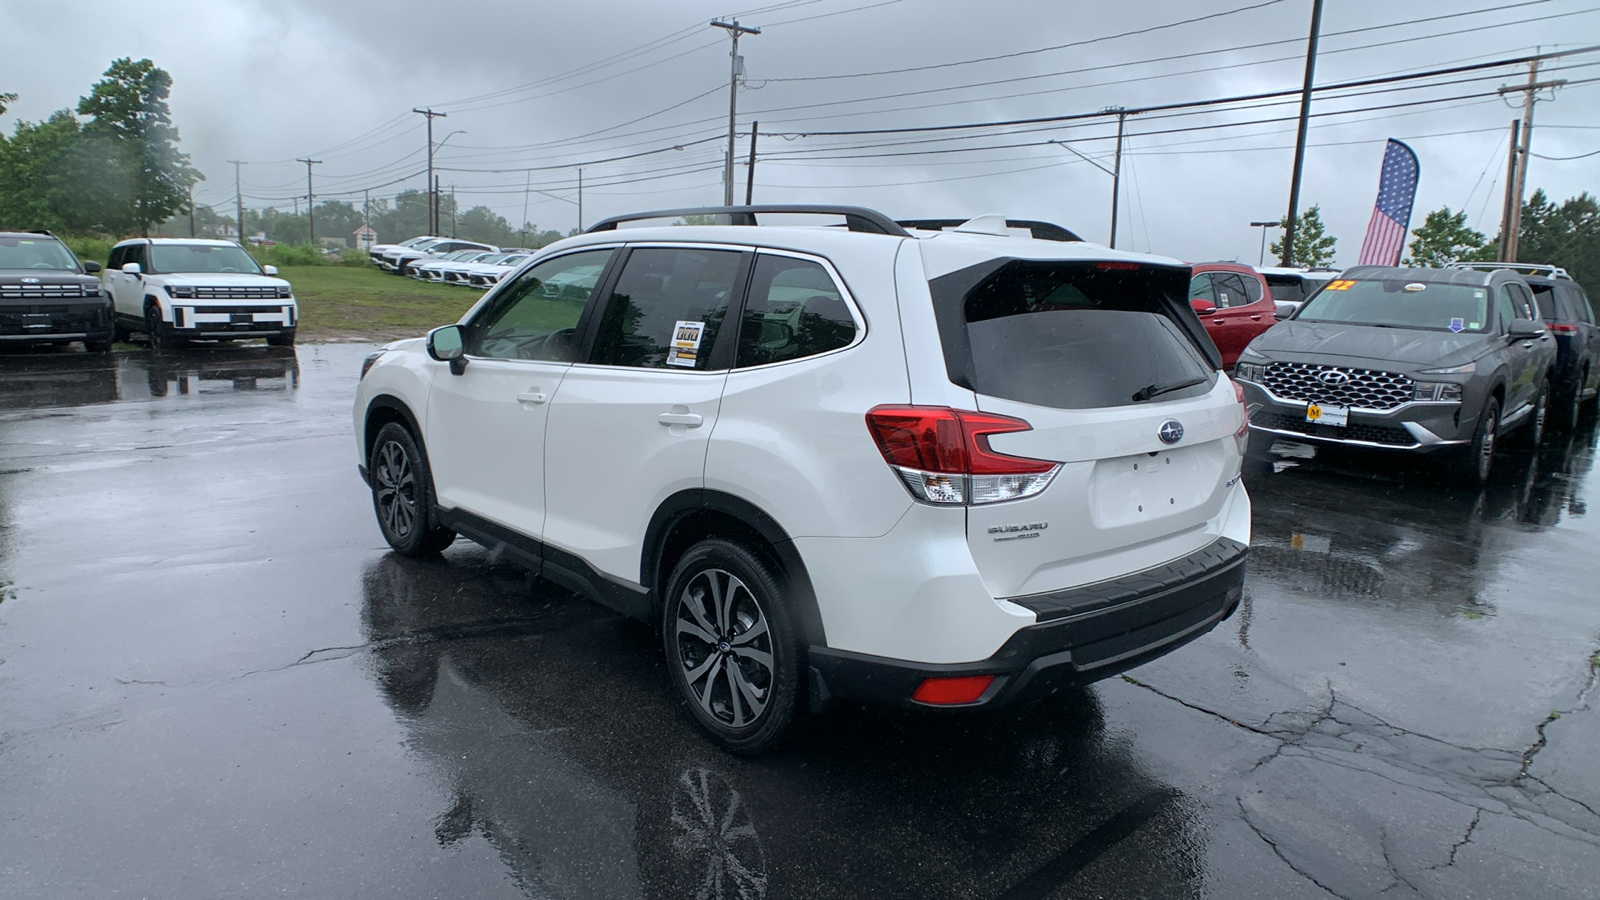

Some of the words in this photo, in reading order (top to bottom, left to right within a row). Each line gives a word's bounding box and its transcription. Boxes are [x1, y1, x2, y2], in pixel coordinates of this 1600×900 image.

[1325, 280, 1357, 291] 22
[1310, 409, 1320, 417] M
[987, 522, 1048, 533] SUBARU
